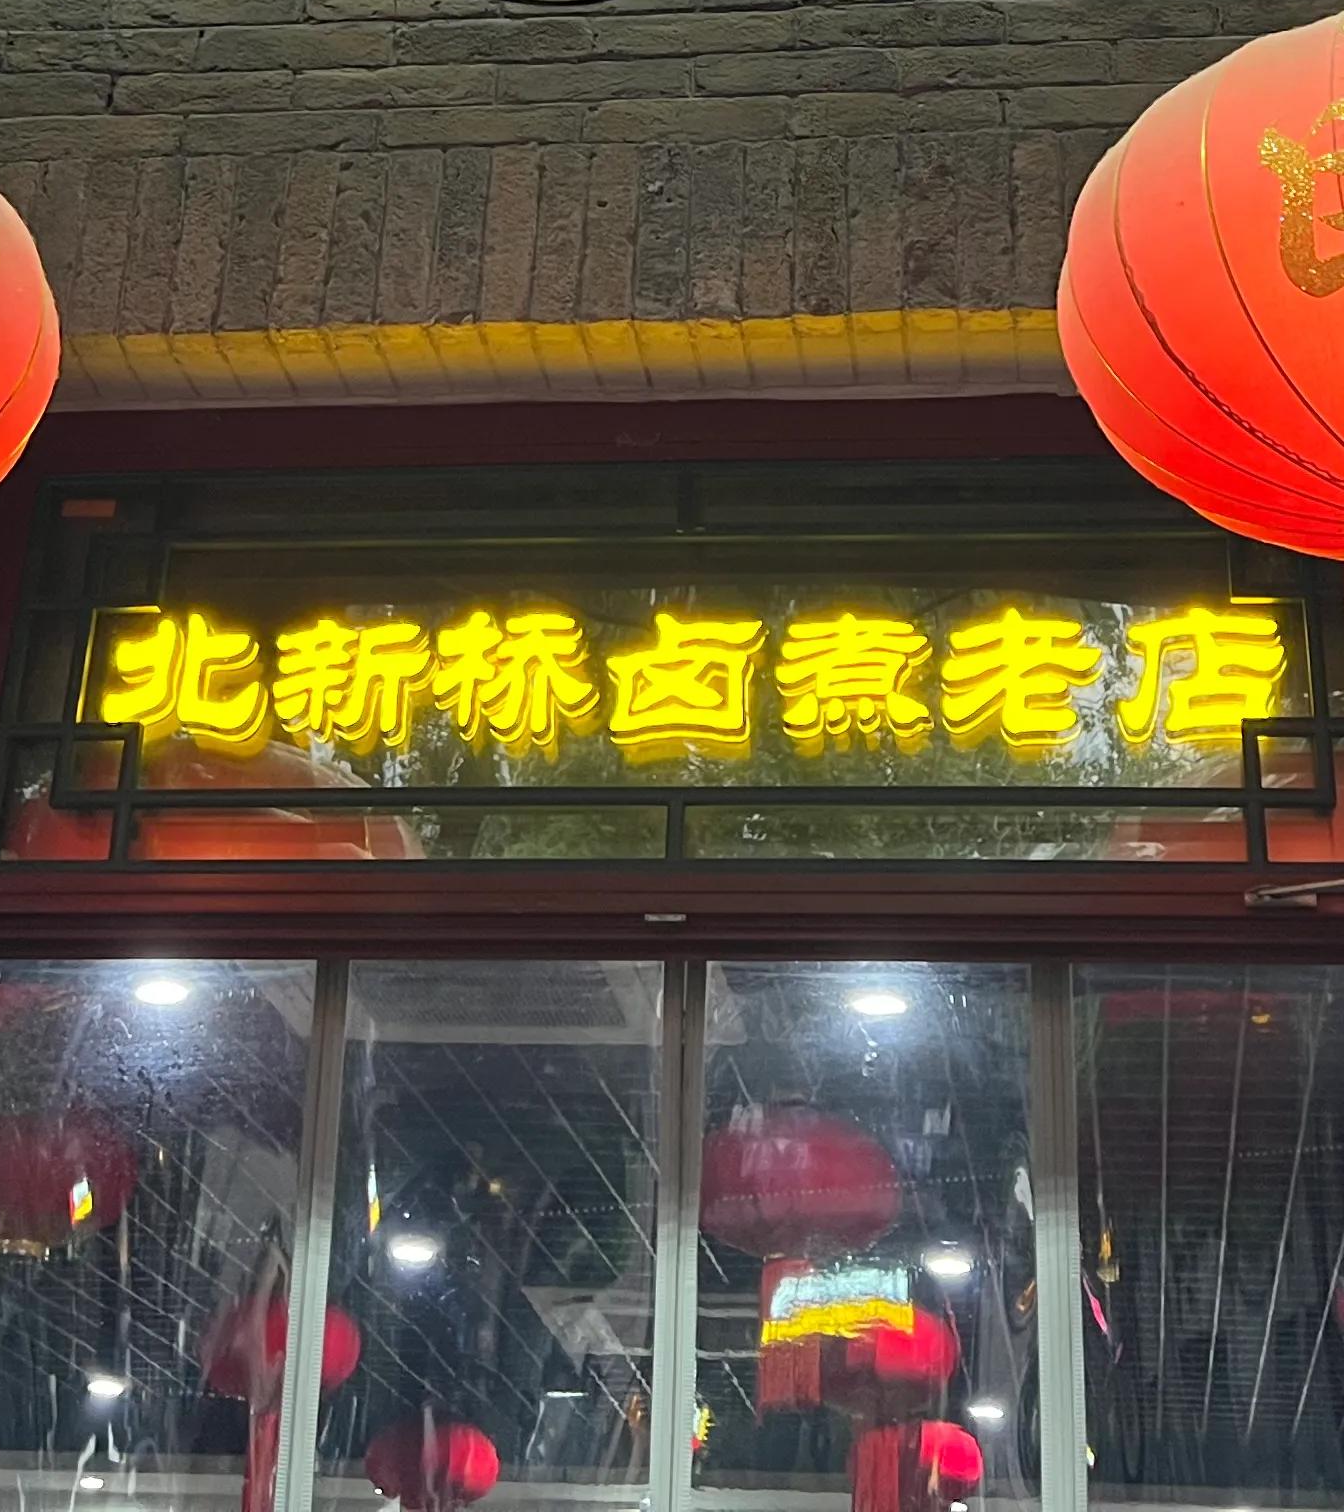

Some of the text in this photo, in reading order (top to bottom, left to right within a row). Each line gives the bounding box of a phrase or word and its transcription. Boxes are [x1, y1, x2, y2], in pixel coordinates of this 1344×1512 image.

[99, 606, 1286, 750] 北新桥卤煮老店
